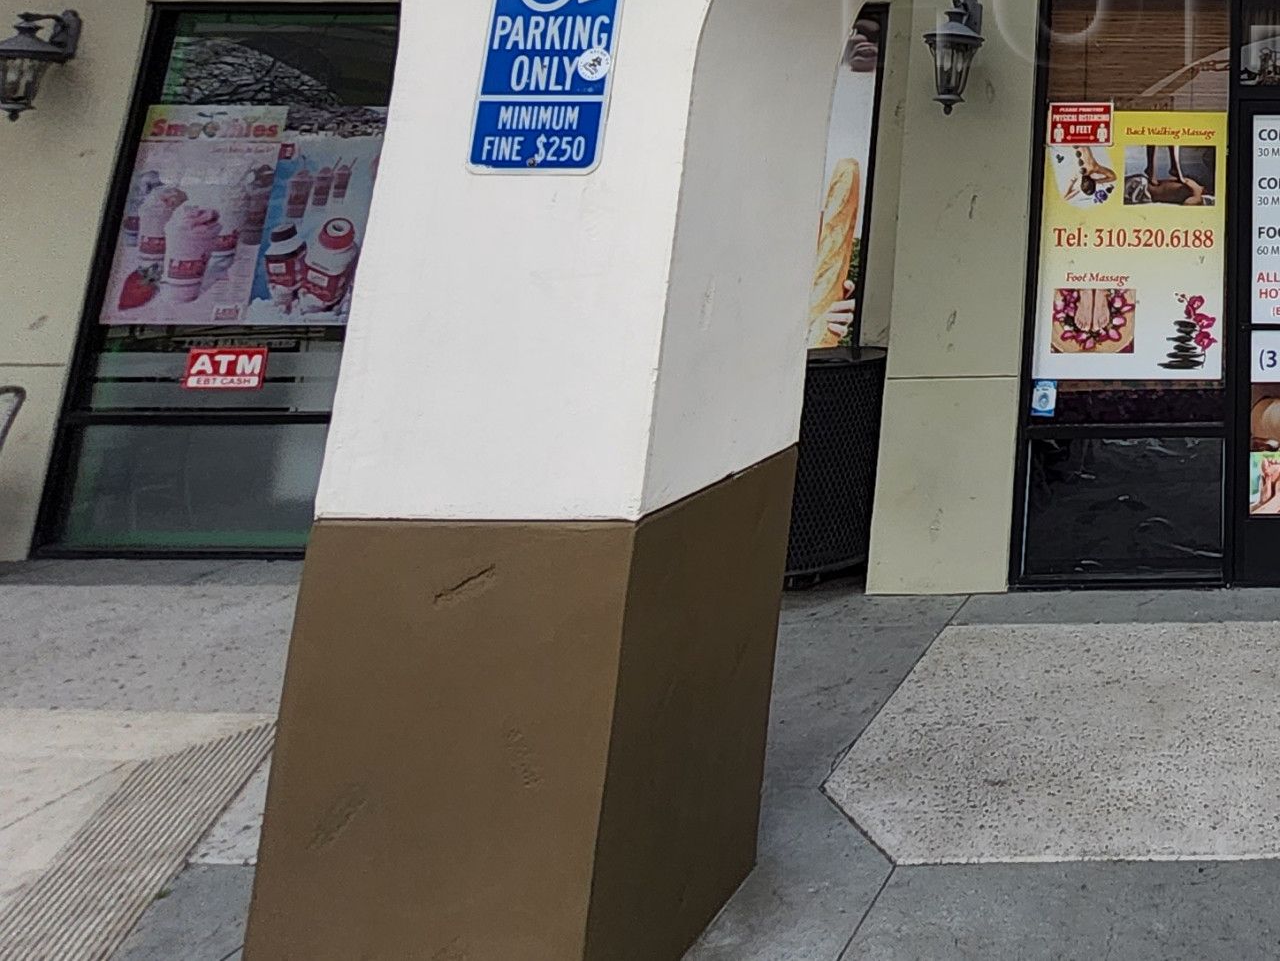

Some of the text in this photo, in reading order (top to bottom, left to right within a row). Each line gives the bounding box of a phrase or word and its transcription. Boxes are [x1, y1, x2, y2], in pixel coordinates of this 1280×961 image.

[493, 15, 610, 50] PARKING
[510, 56, 579, 91] ONLY
[498, 106, 579, 130] MINIMUM
[1076, 125, 1092, 134] FEET
[1126, 127, 1146, 136] Back
[1182, 128, 1216, 139] Massage
[482, 133, 585, 161] FINE $250
[1258, 147, 1269, 156] 30
[1258, 196, 1269, 205] 30
[1053, 228, 1214, 248] Tel: 310.320.6188
[1257, 246, 1268, 255] 60
[1066, 272, 1130, 286] Foot Massage
[1257, 272, 1280, 283] ALL
[190, 354, 262, 374] ATM
